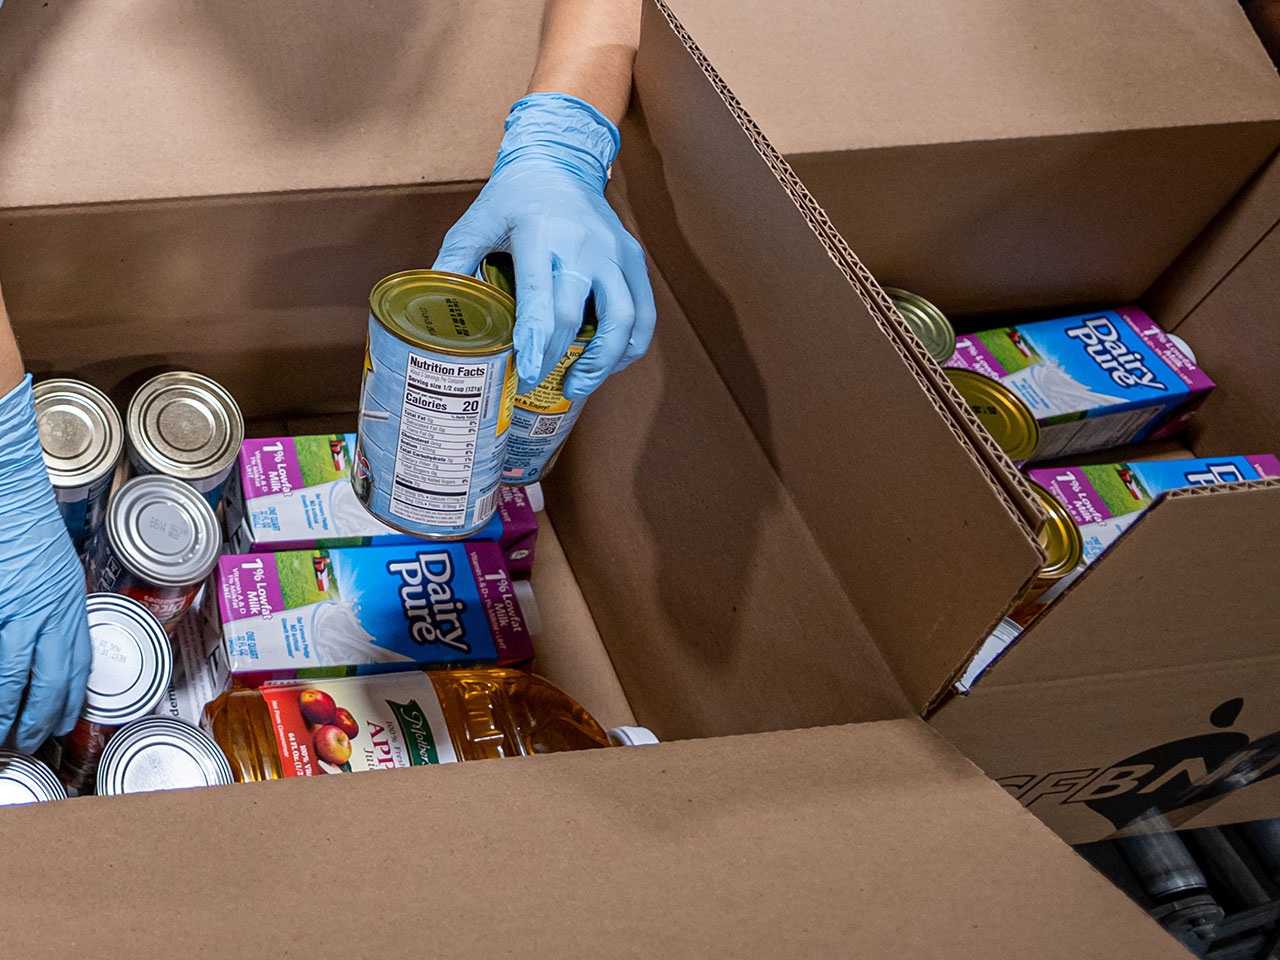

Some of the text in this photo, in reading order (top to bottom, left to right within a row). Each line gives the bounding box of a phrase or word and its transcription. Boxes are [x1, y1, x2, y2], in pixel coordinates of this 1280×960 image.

[410, 356, 485, 376] Nutrition Facts
[1067, 326, 1136, 388] Pure
[1085, 317, 1168, 390] Dairy
[408, 375, 428, 387] Serving
[405, 410, 416, 418] Total
[406, 393, 479, 412] Calories 20
[262, 441, 294, 497] 1% Lowfat
[268, 471, 280, 492] Milk
[1056, 471, 1082, 493] 1%
[1078, 493, 1107, 527] Lowfat
[1073, 500, 1093, 522] Milk
[241, 558, 273, 620] 1% Lowfat
[246, 590, 259, 615] Milk
[389, 561, 436, 642] Pure
[418, 552, 468, 651] Dairy
[484, 568, 522, 632] 1% Lowfat
[494, 602, 510, 627] Milk
[276, 721, 290, 758] Concentrate
[366, 720, 395, 770] APP
[386, 720, 398, 744] 100%
